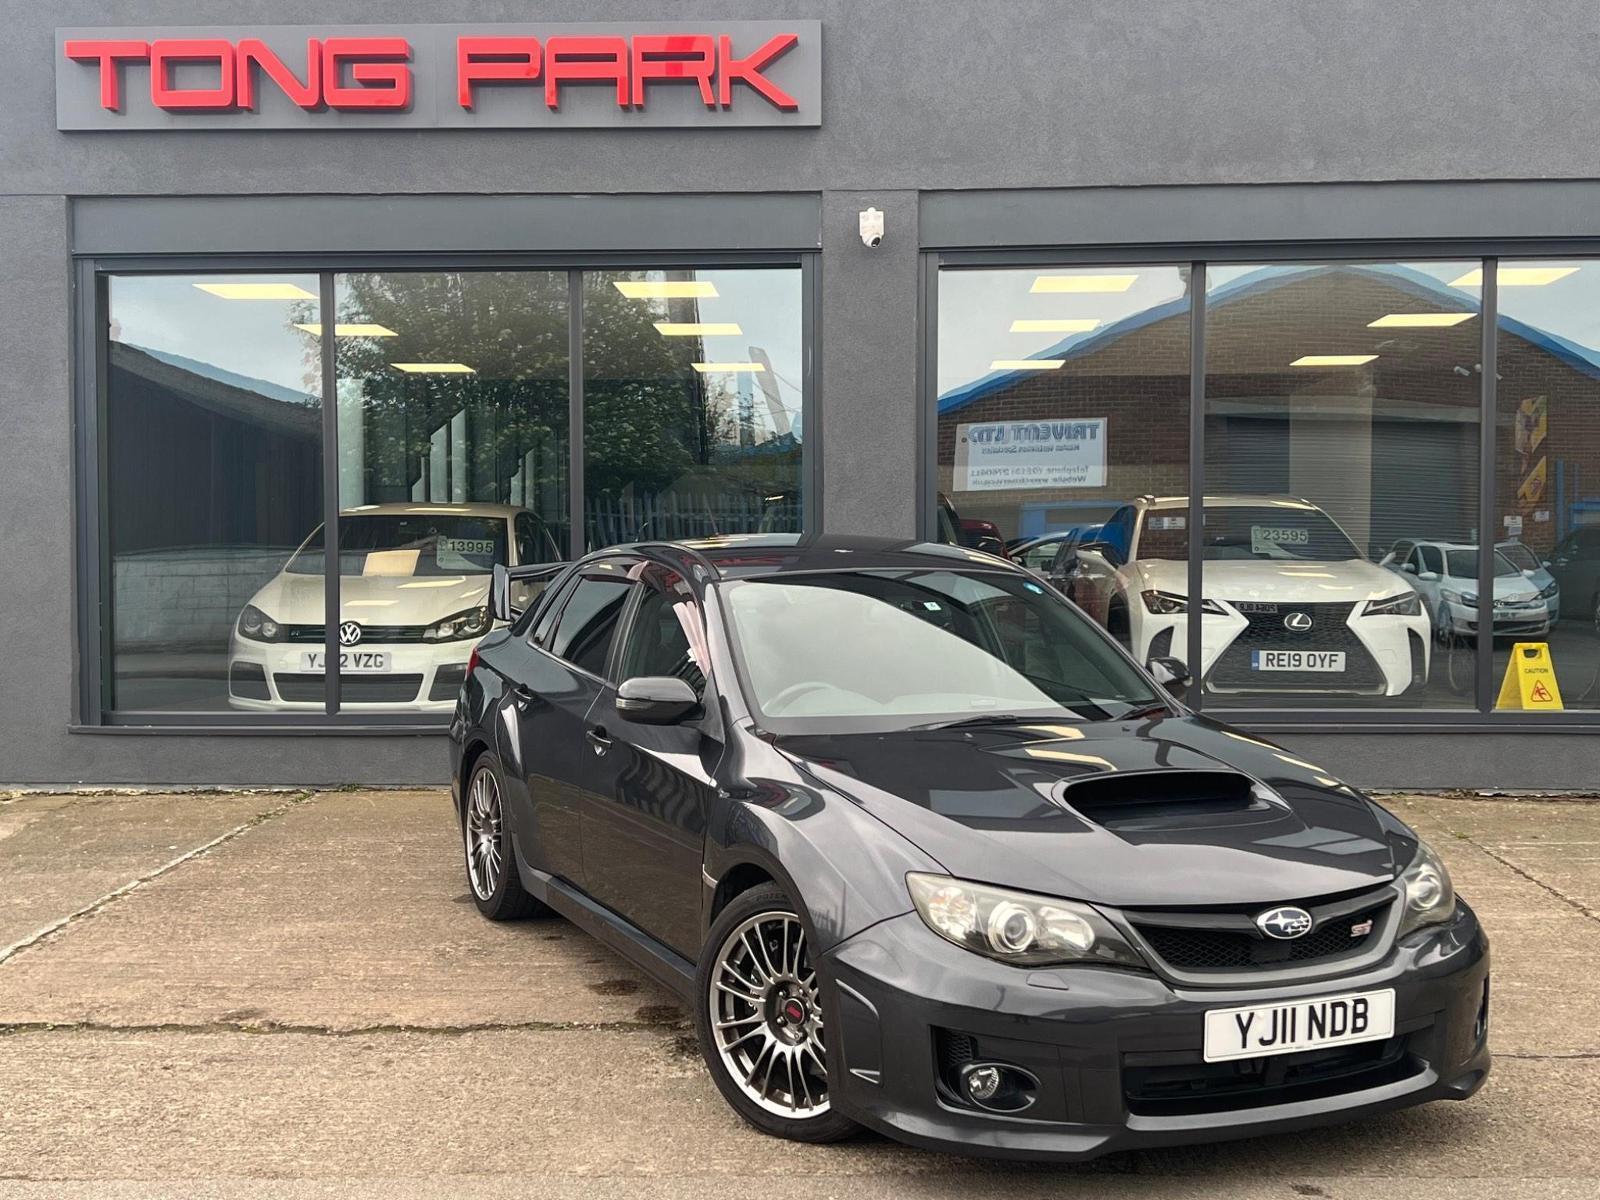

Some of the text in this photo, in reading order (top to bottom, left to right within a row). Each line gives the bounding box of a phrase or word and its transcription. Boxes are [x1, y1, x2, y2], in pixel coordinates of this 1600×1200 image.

[64, 33, 799, 116] TONG PARK
[1263, 529, 1308, 543] 23595
[449, 540, 494, 554] 13995
[308, 653, 384, 669] Y2 VZG
[1265, 652, 1339, 669] RE19 OYF
[1235, 997, 1369, 1049] YJ11 NDB
